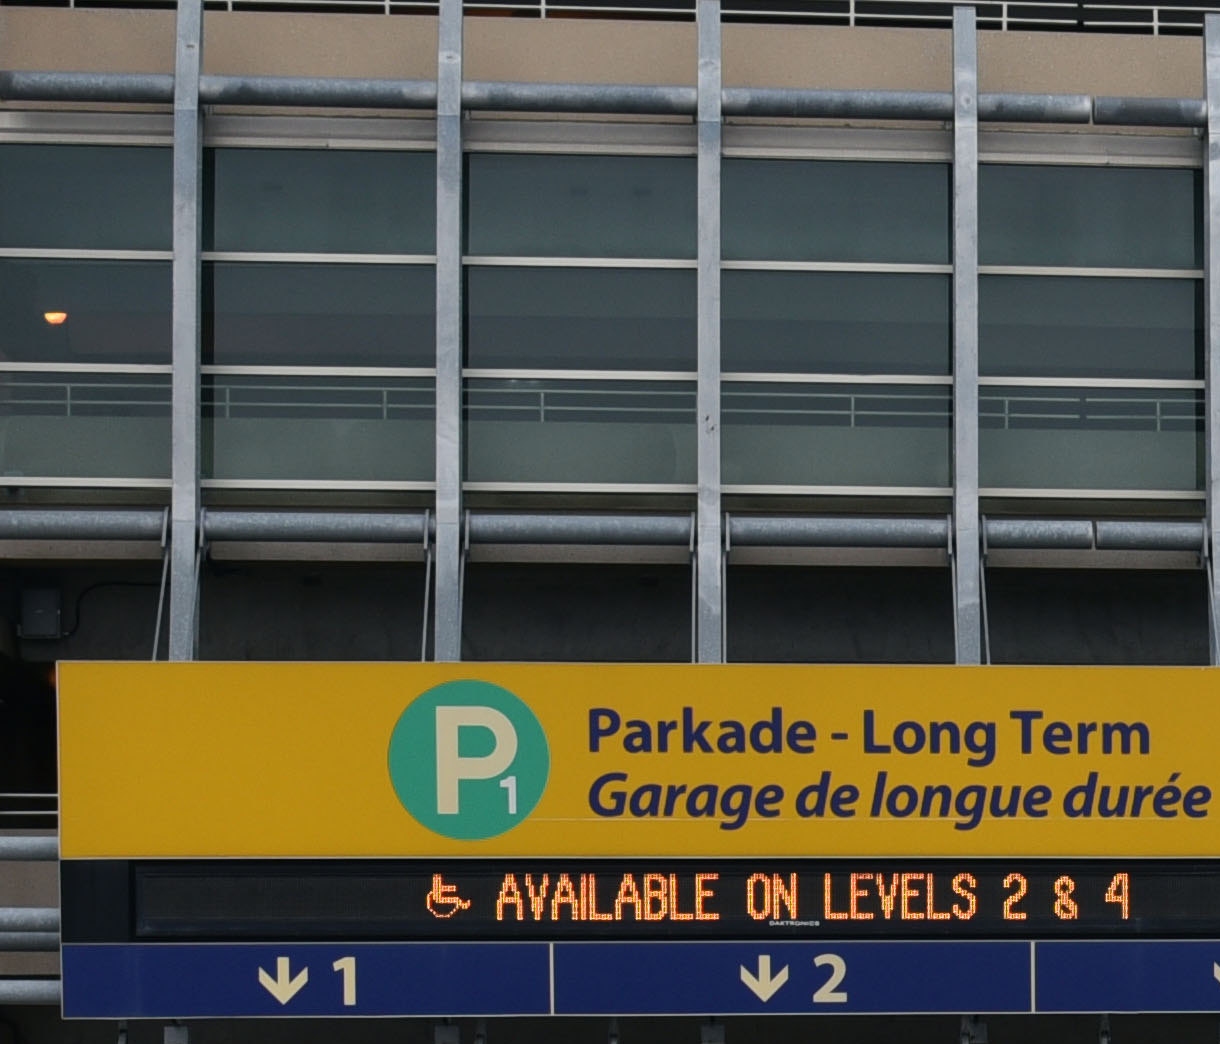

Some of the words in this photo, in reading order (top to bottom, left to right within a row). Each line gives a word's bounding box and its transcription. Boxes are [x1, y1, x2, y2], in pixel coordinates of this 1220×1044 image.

[589, 707, 817, 753] Parkade
[863, 709, 996, 767] Long
[1010, 710, 1150, 755] Term
[588, 773, 785, 830] Garage
[796, 771, 859, 818] de
[870, 771, 1053, 830] longue
[1063, 772, 1212, 819] durée
[496, 873, 720, 921] AVAILABLE
[747, 873, 798, 921] ON
[824, 873, 977, 921] LEVELS
[1003, 873, 1028, 921] 2
[1054, 875, 1078, 920] &
[1105, 873, 1129, 920] 4
[333, 956, 357, 1006] 1
[812, 953, 848, 1003] 2
